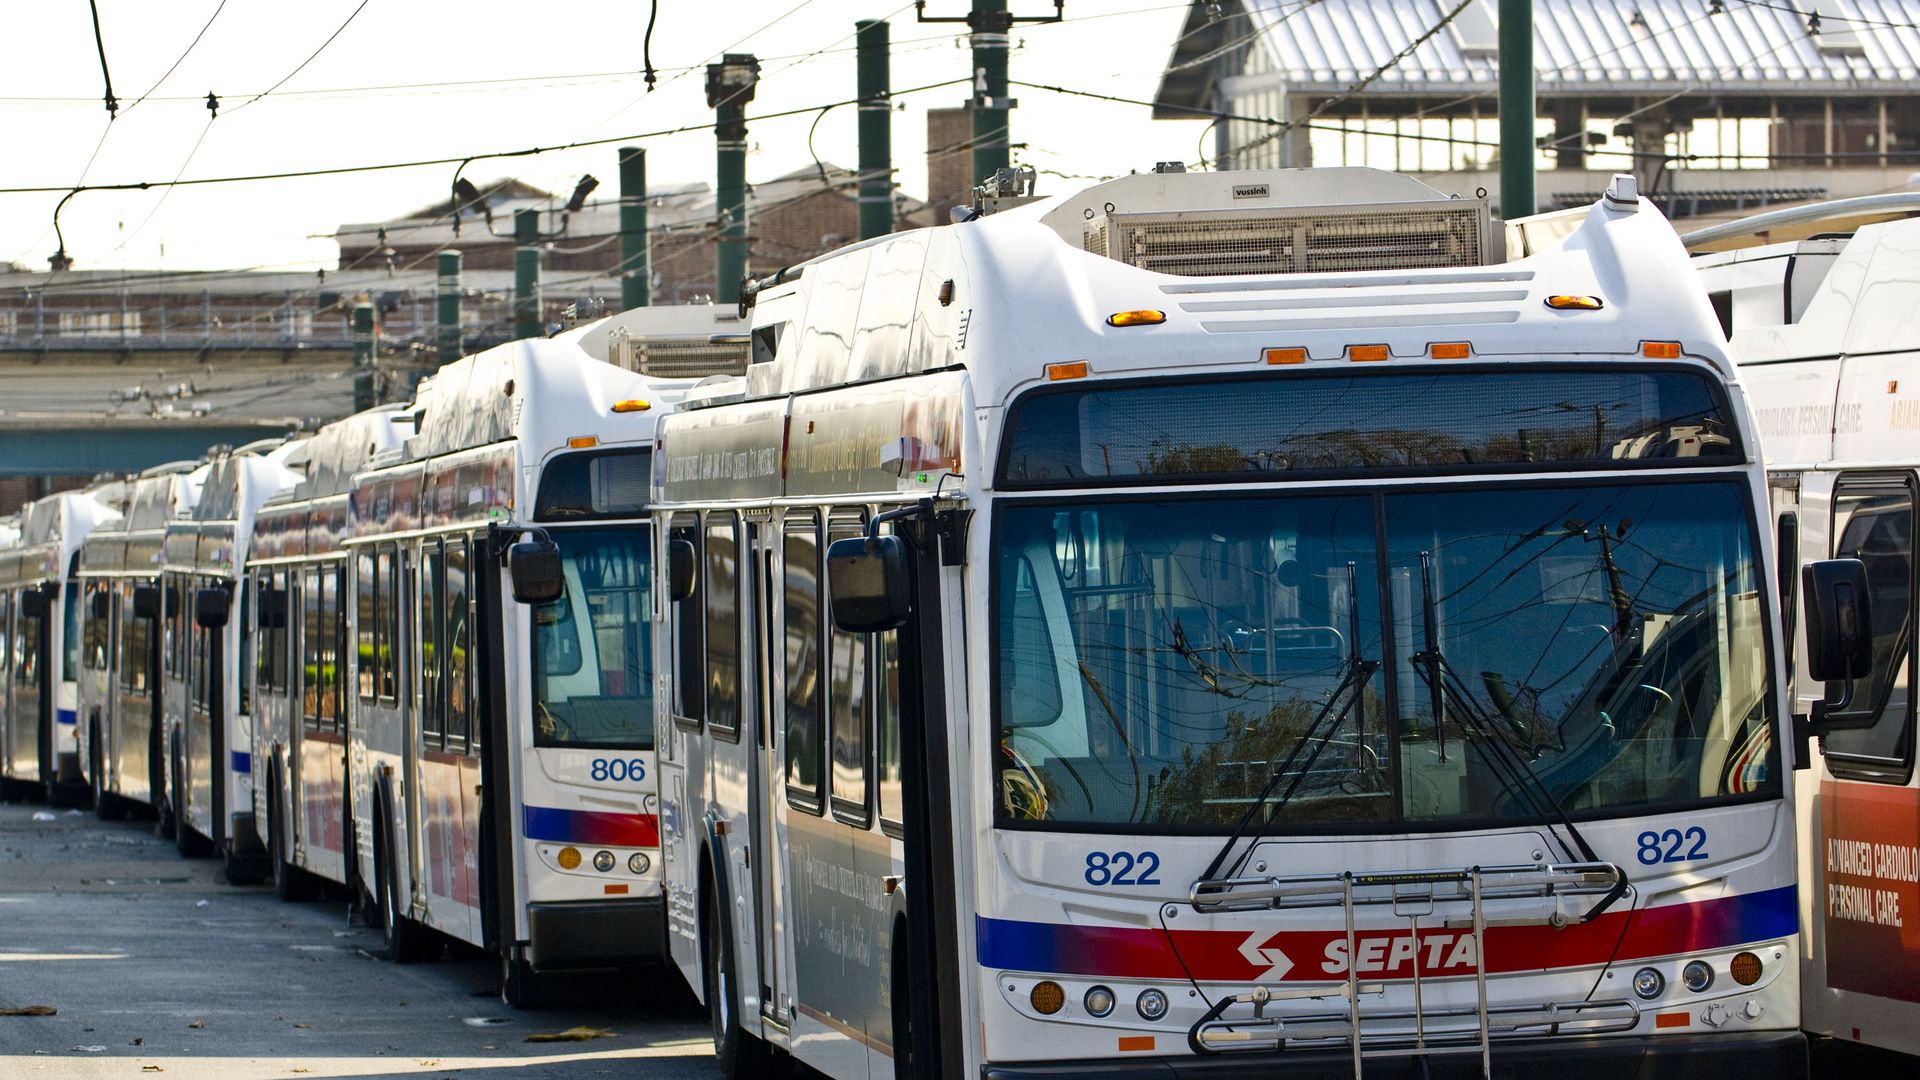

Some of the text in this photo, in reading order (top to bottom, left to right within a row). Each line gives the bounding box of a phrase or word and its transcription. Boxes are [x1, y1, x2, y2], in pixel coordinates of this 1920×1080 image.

[591, 758, 646, 782] 806
[1637, 826, 1709, 866] 822
[1828, 838, 1872, 877] ADVANCED
[1084, 851, 1161, 886] 822
[1828, 883, 1902, 927] PERSONAL CARE.
[1321, 933, 1480, 974] SEPTA
